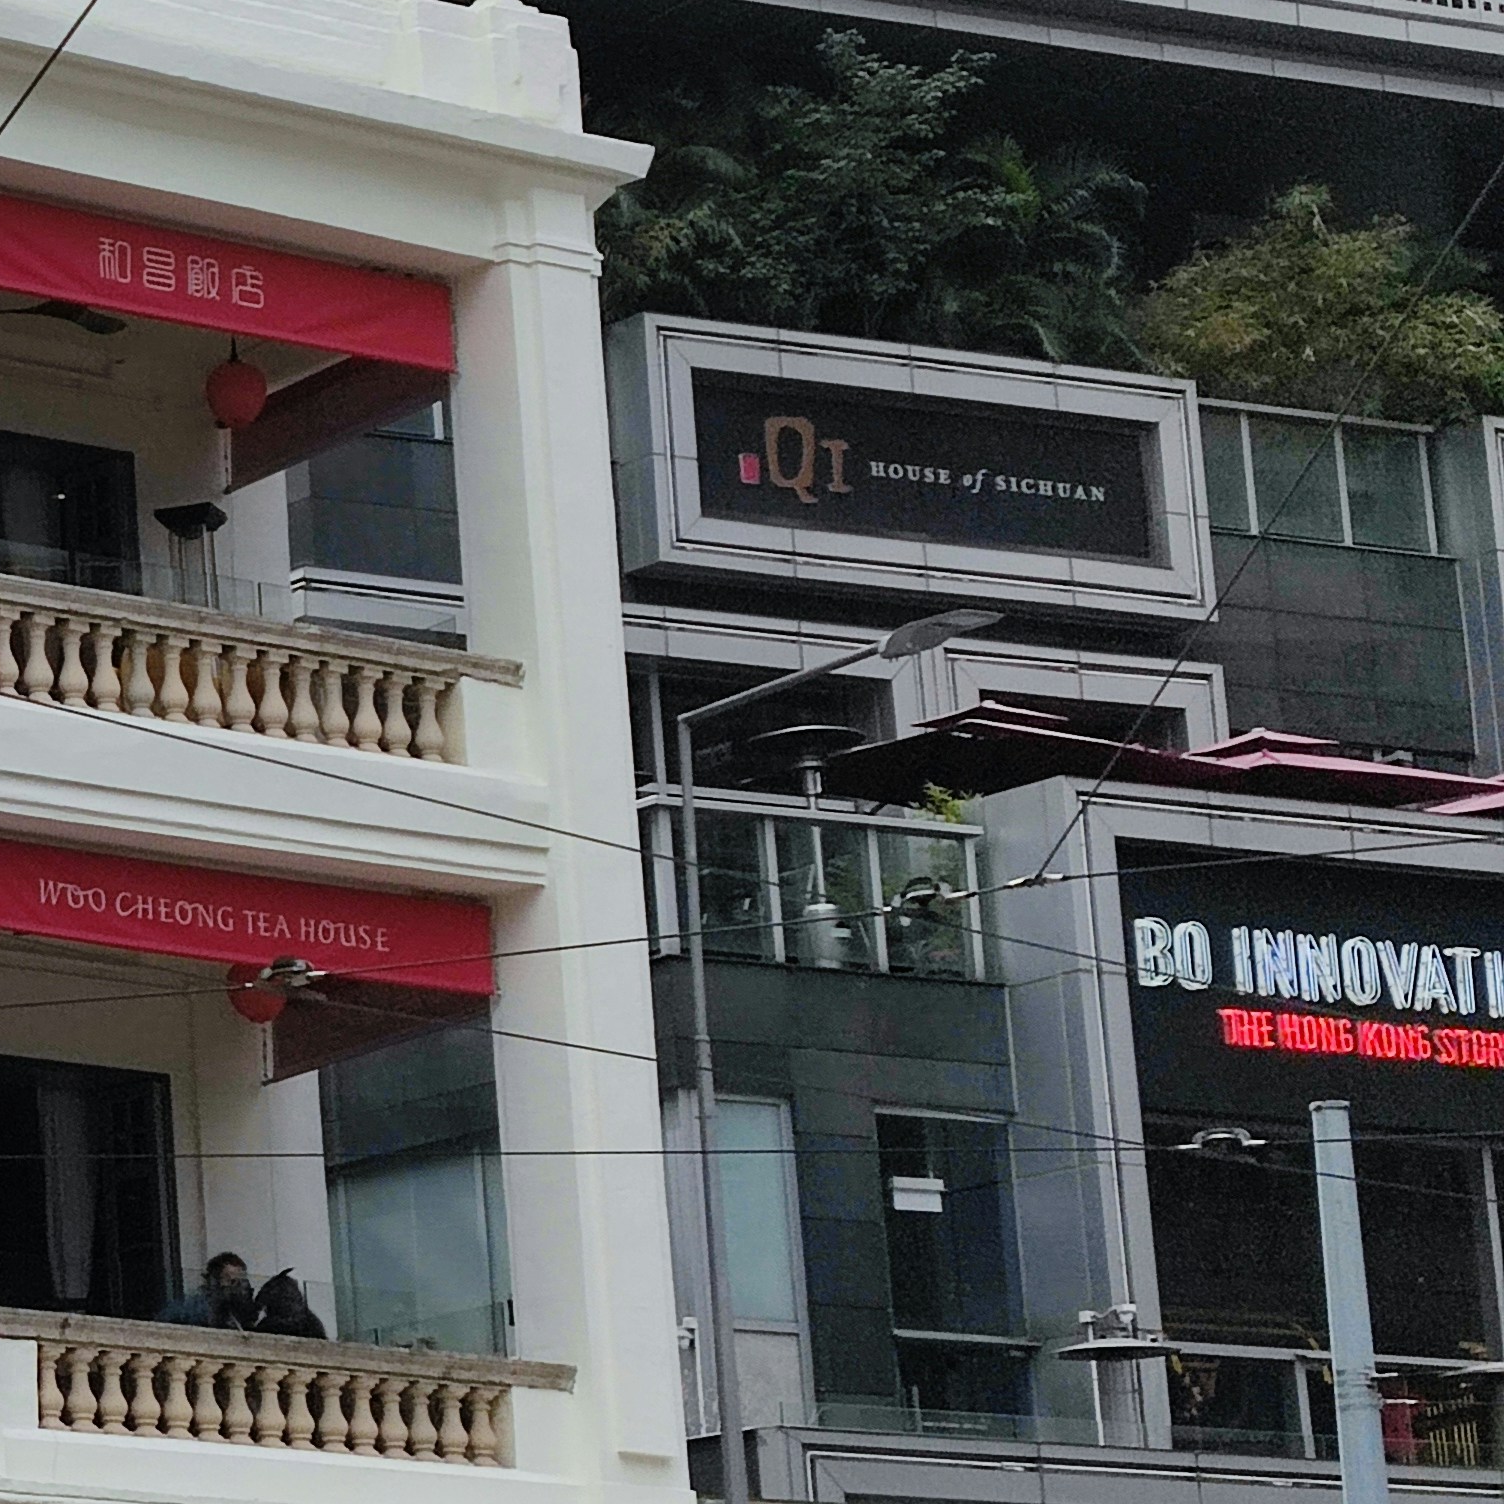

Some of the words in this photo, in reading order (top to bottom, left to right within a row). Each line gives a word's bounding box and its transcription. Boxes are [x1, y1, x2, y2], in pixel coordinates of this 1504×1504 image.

[98, 236, 265, 309] 和昌飯店
[869, 460, 951, 485] HOUSE
[962, 468, 989, 494] of
[994, 475, 1106, 502] SICHUAN
[38, 878, 107, 914] WOO
[115, 891, 235, 932] CHEONG
[242, 909, 292, 939] TEA
[299, 917, 391, 953] HOUSE
[1133, 916, 1213, 990] BO
[1216, 1007, 1276, 1048] THE
[1277, 1012, 1353, 1054] HONG
[1358, 1019, 1431, 1060] KONG
